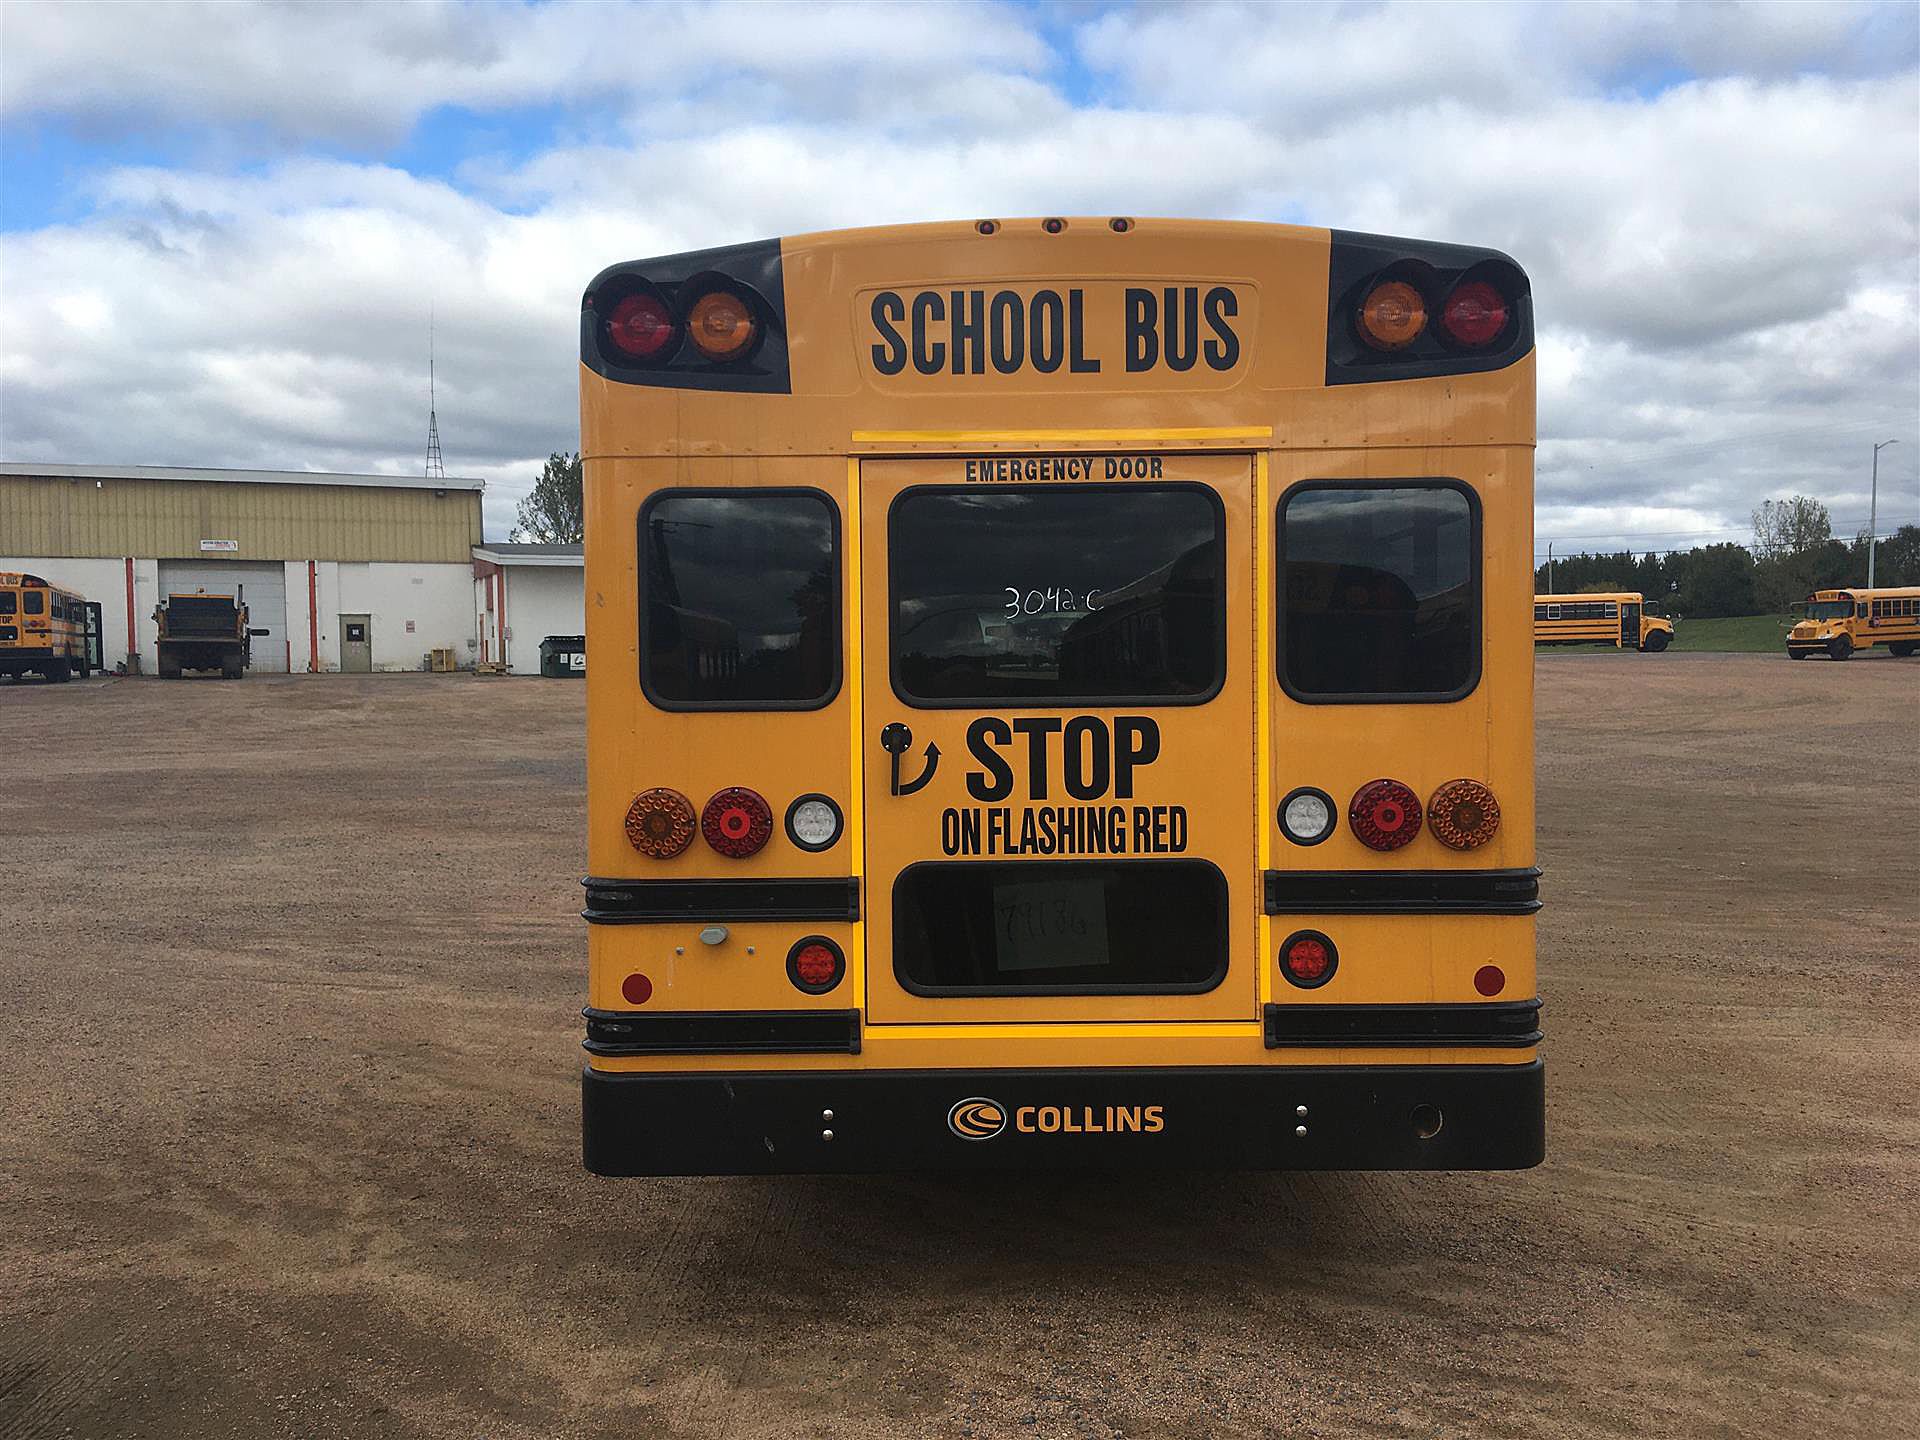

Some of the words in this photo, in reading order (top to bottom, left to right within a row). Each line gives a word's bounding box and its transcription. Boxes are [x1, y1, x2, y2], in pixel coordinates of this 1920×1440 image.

[871, 287, 1101, 376] SCHOOL
[1125, 286, 1241, 373] BUS
[966, 458, 1093, 482] EMERGENCY
[1105, 457, 1163, 479] DOOR
[966, 716, 1160, 802] STOP
[942, 807, 981, 855] ON
[988, 806, 1126, 855] FLASHING
[1133, 806, 1187, 852] RED
[1016, 1106, 1164, 1133] COLLINS
